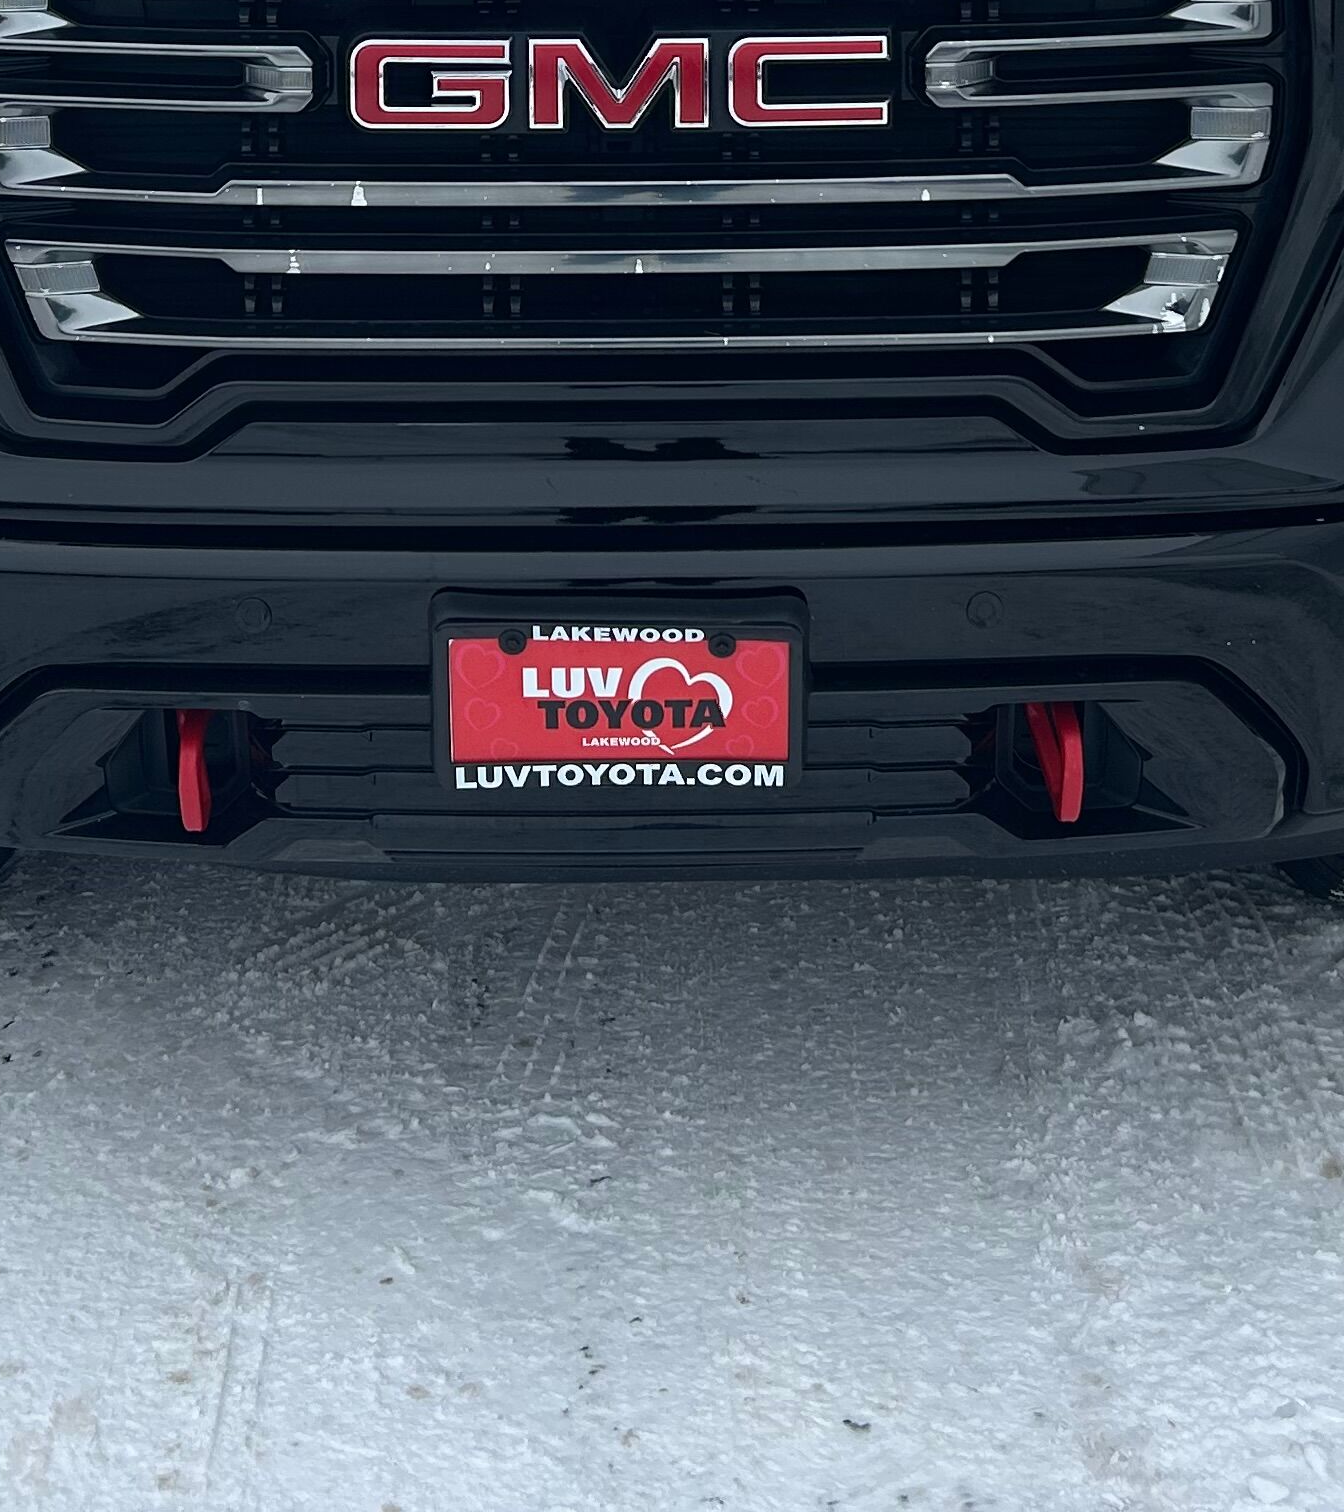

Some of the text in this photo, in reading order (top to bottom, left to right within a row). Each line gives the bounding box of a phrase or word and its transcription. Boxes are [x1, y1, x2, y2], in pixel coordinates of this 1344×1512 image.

[350, 35, 889, 129] GMC
[532, 625, 705, 643] LAKEWOOD
[522, 667, 623, 698] LUV
[537, 699, 726, 729] TOYOTA
[582, 736, 661, 747] LAKEWOOD
[456, 763, 785, 789] LUVTOYOTA.COM
